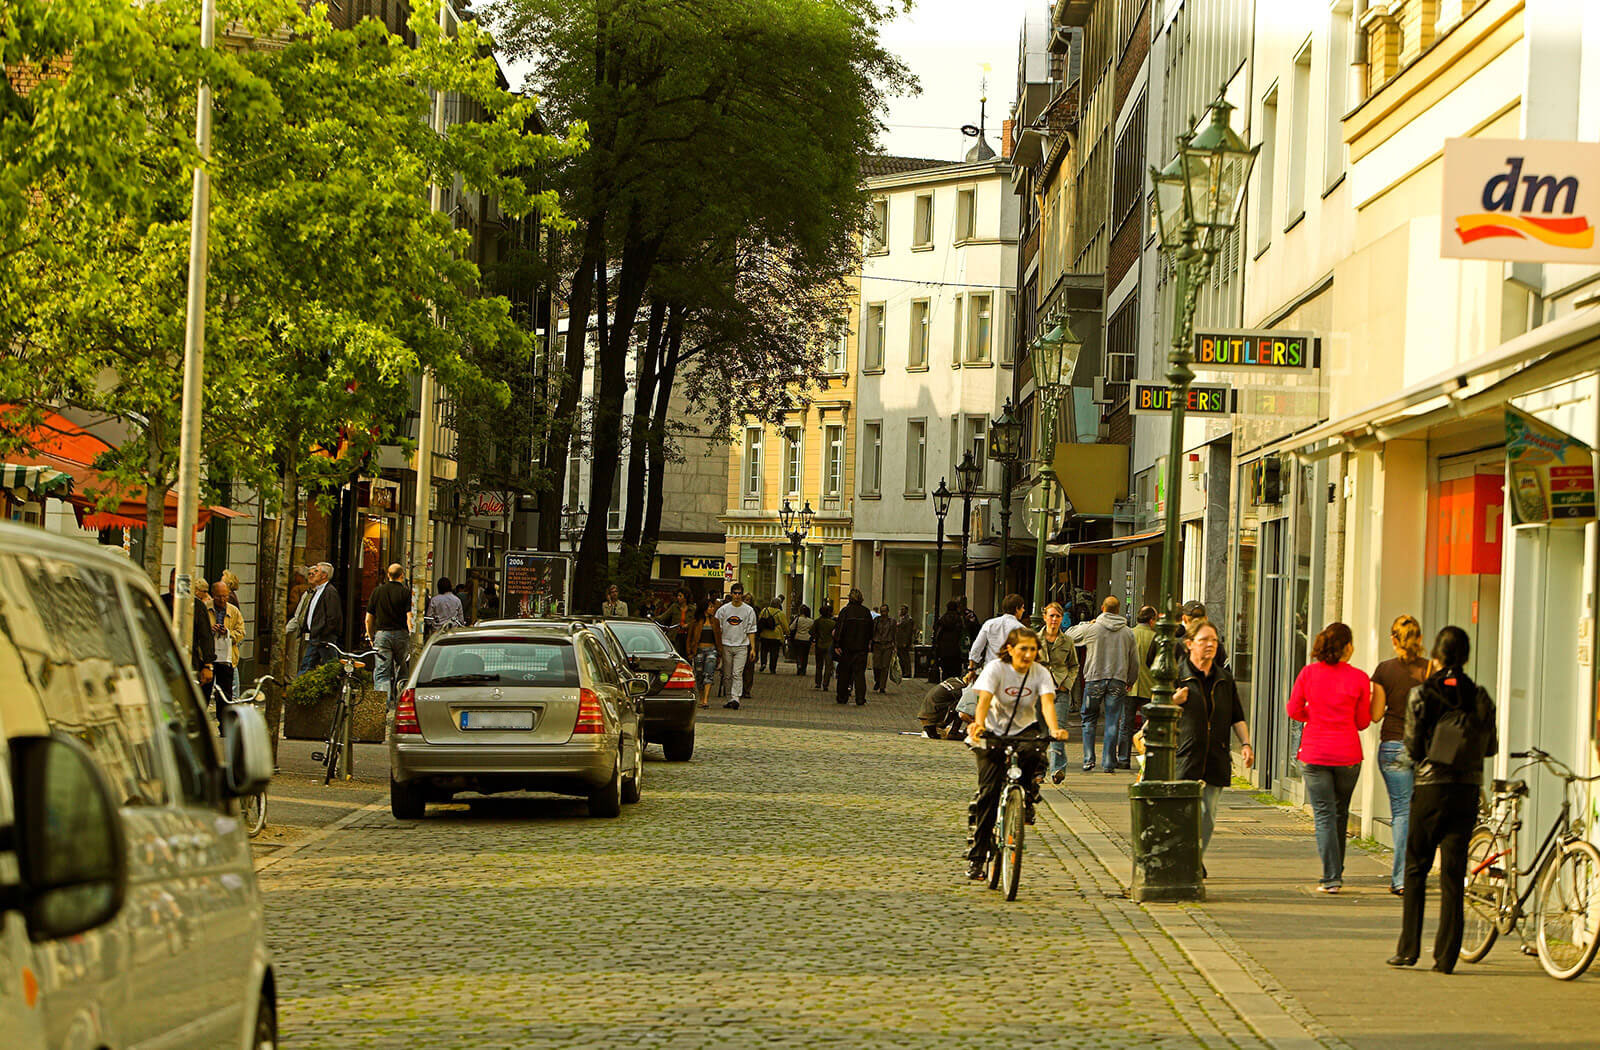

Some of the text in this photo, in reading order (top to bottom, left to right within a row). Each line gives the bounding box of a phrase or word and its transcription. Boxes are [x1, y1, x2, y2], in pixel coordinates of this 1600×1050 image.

[1482, 156, 1579, 215] dm
[1202, 338, 1301, 366] BUTLERS
[1141, 388, 1221, 412] BUTERS
[509, 558, 524, 566] 2006
[682, 558, 725, 570] PLANET
